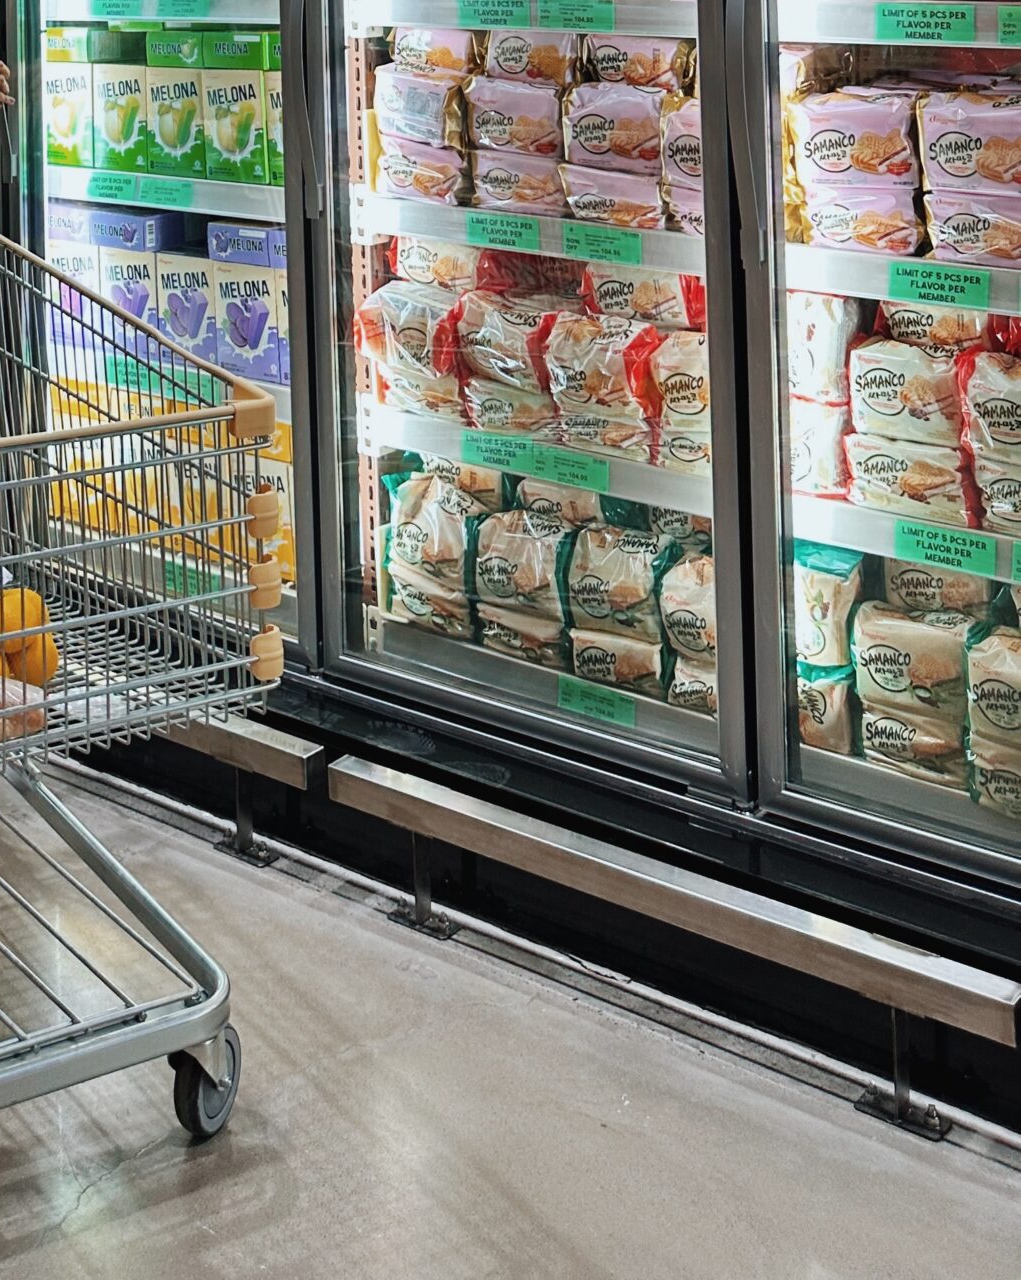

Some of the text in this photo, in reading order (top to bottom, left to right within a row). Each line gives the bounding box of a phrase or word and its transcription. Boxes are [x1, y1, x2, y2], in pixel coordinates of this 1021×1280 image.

[882, 9, 906, 17] LIMIT
[921, 10, 927, 18] 5
[930, 11, 947, 19] PCS
[896, 21, 931, 29] FLAVOR
[905, 31, 942, 40] MEMBER
[151, 43, 182, 55] MELONA
[215, 43, 248, 55] MELONA
[98, 79, 141, 98] MELONA
[151, 82, 198, 102] MELONA
[207, 84, 257, 108] MELONA
[475, 115, 514, 129] SAMANCO
[572, 119, 615, 139] SAMANCO
[804, 134, 855, 158] SAMANCO
[929, 137, 982, 161] SAMANCO
[93, 222, 126, 238] MELONA
[228, 237, 265, 253] MELONA
[105, 265, 151, 282] MELONA
[161, 272, 209, 290] MELONA
[896, 268, 981, 284] LIMIT OF 5 PCS PER
[219, 280, 271, 299] MELONA
[910, 280, 966, 294] FLAVOR PER
[918, 292, 956, 303] MEMBER
[855, 373, 905, 391] SAMANCO
[902, 527, 987, 550] LIMIT OF 5 PCS PER
[916, 540, 972, 559] FLAVOR PER
[924, 553, 963, 568] MEMBER
[890, 576, 943, 591] SAMANCO
[666, 617, 706, 630] SAMANCO
[577, 653, 616, 667] SAMANCO
[860, 652, 911, 667] SAMANCO
[866, 722, 916, 741] SAMANCO
